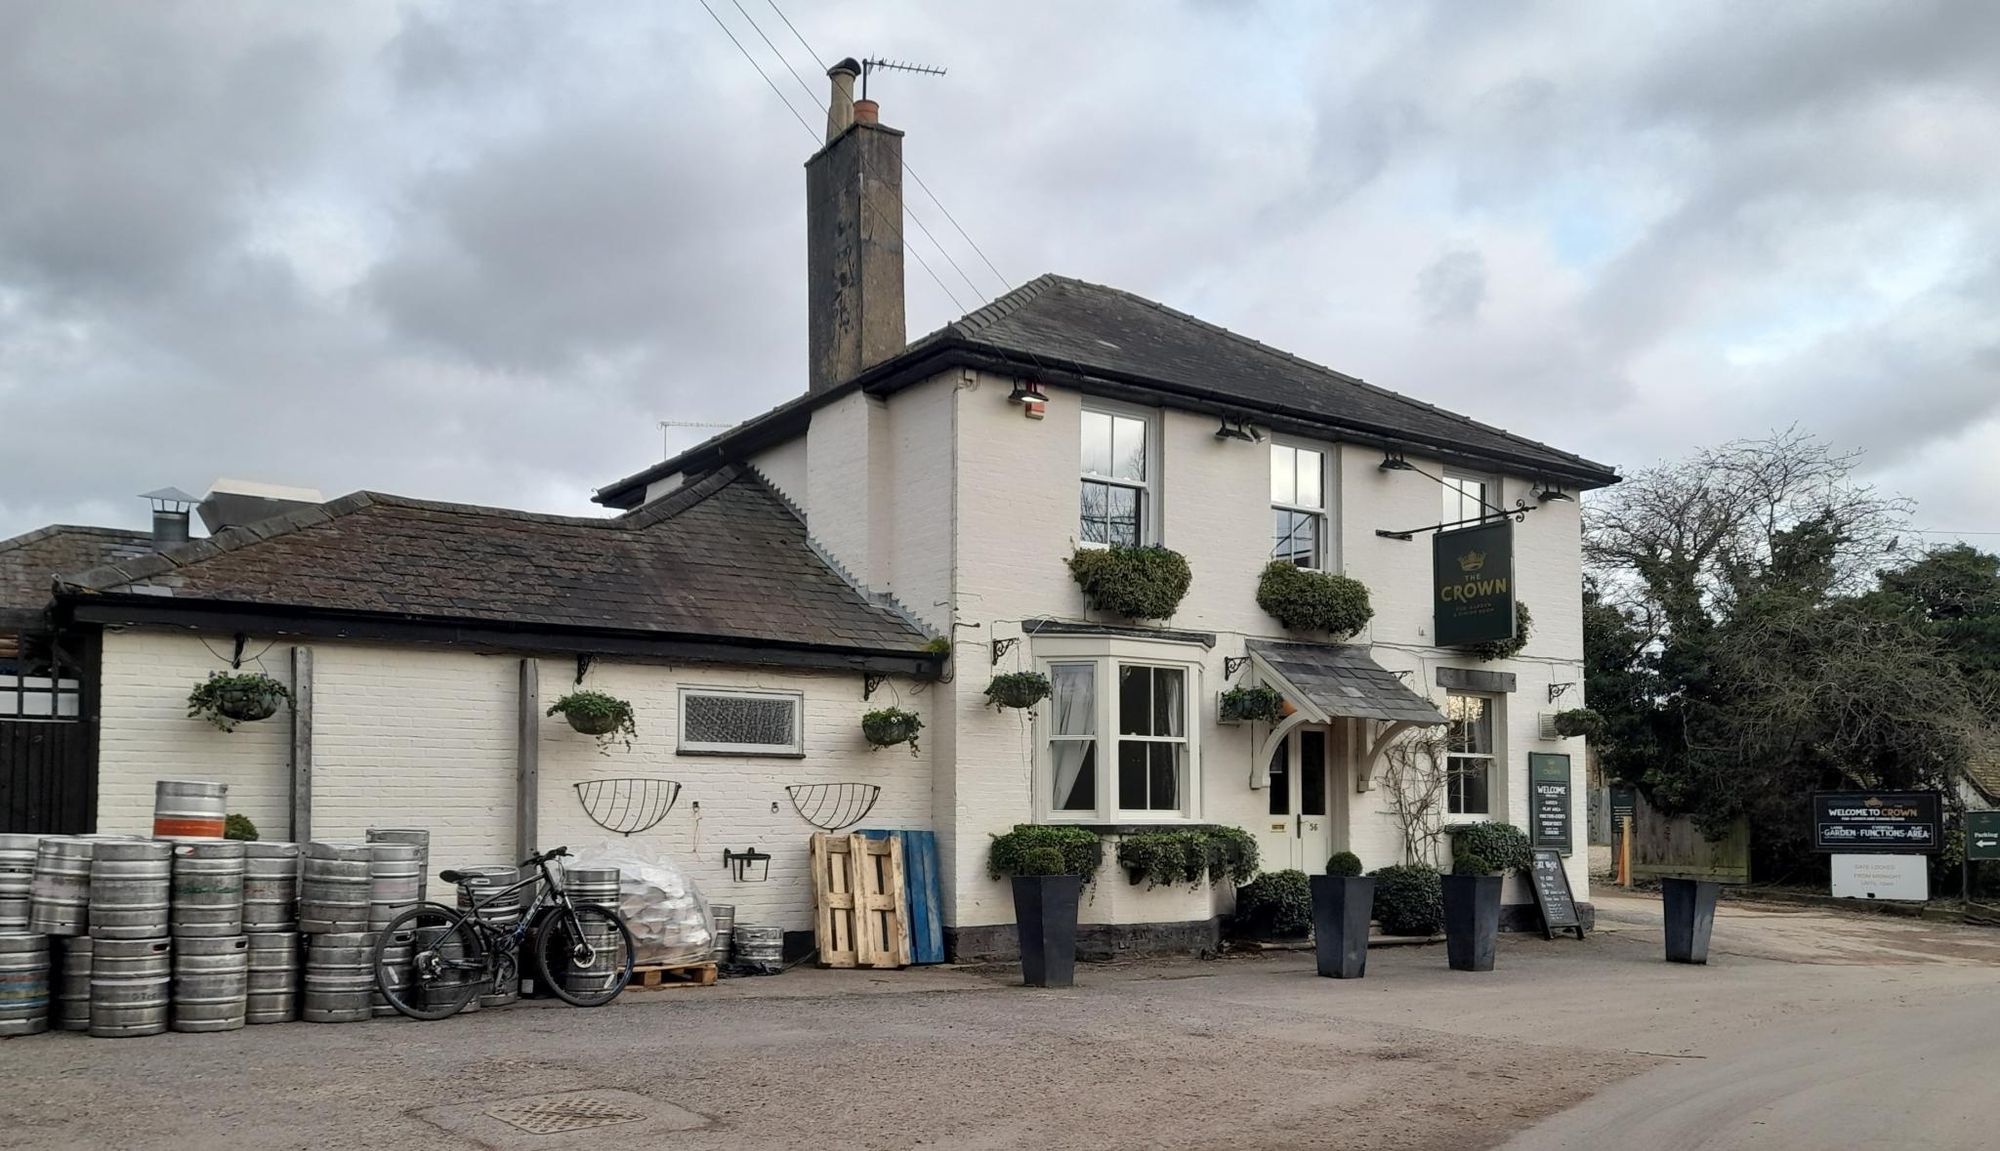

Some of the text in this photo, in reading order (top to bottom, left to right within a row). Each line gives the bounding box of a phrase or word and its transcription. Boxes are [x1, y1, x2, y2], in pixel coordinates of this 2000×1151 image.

[1464, 573, 1480, 582] THE
[1441, 577, 1507, 603] CROWN
[1537, 785, 1566, 794] WELCOME
[1828, 808, 1918, 817] WELCOME TO CROWN
[1824, 829, 1929, 838] GARDEN FUNCTIONS AREA
